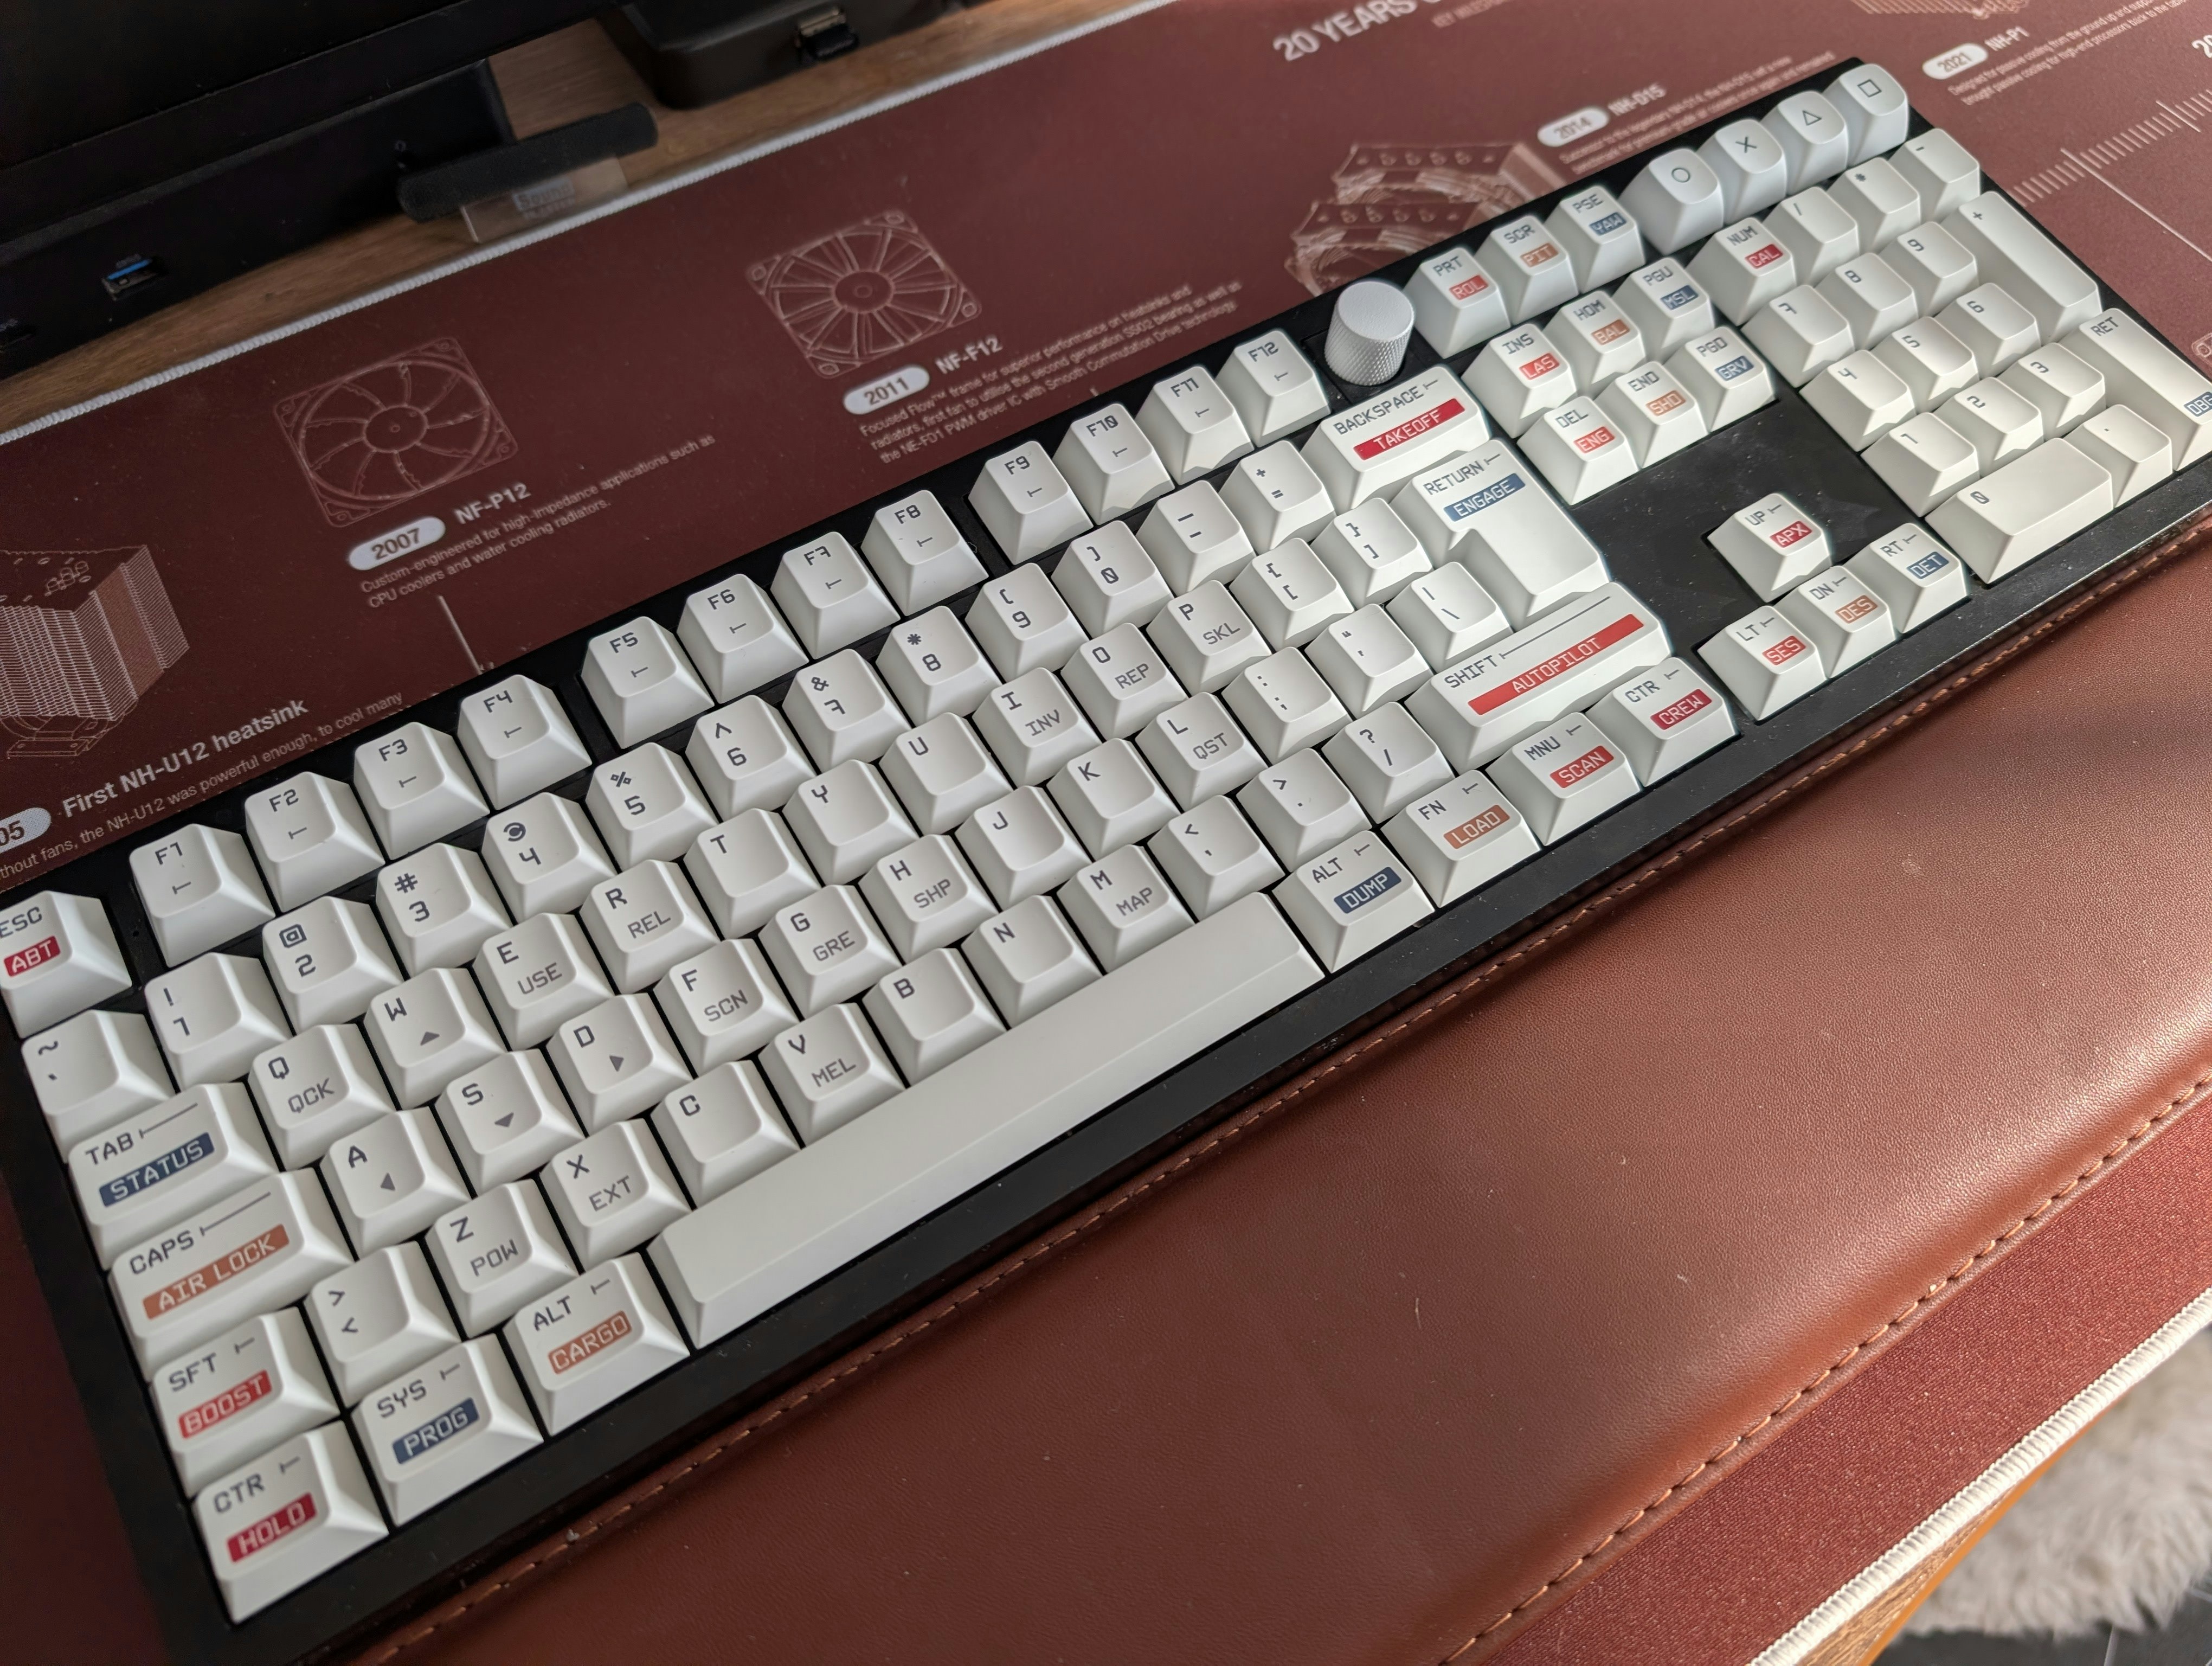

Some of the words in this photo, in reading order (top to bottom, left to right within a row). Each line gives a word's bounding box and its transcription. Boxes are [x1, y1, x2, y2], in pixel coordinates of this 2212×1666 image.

[1272, 28, 1320, 62] 20
[1311, 0, 1418, 43] YEARS
[1984, 26, 2030, 52] NH-P1
[2048, 35, 2070, 48] from
[2066, 29, 2082, 40] the
[2079, 16, 2107, 35] ground
[2091, 23, 2132, 46] processors
[2127, 14, 2150, 27] back
[1938, 52, 1972, 73] 2021
[1554, 117, 1592, 139] 2014
[1572, 194, 1604, 213] PSE
[1504, 225, 1533, 243] SCR
[1728, 226, 1757, 243] NUM
[1432, 256, 1462, 276] PRT
[1523, 246, 1554, 266] PIT
[1748, 247, 1780, 267] CAL
[1643, 266, 1674, 286] PGU
[1452, 279, 1484, 298] ROL
[1663, 289, 1695, 309] MSL
[1573, 299, 1606, 321] HOM
[1595, 325, 1628, 344] BAL
[2091, 317, 2118, 336] RET
[934, 334, 1003, 374] NF-F12
[1248, 342, 1278, 362] F12
[1503, 334, 1534, 354] INS
[1696, 337, 1727, 356] PGD
[1522, 356, 1555, 378] LAS
[1718, 360, 1750, 380] GRV
[864, 377, 910, 406] 2011
[1171, 378, 1199, 397] F11
[1628, 371, 1660, 392] END
[880, 448, 901, 464] the
[944, 414, 977, 435] PWM
[976, 402, 1007, 421] driver
[1020, 385, 1047, 401] with
[1044, 366, 1088, 390] Smooth
[923, 410, 947, 427] first
[946, 402, 966, 417] fan
[1333, 386, 1424, 435] BACKSPACE
[1649, 393, 1682, 414] SHD
[2187, 395, 2212, 415] DBG
[859, 409, 909, 436] Focused
[1086, 415, 1118, 437] F10
[1373, 409, 1443, 450] TAKEOFF
[1555, 410, 1589, 428] DEL
[1578, 430, 1609, 452] ENG
[1005, 456, 1030, 475] F9
[1423, 460, 1485, 496] RETURN
[454, 482, 531, 524] NF-P12
[1453, 479, 1516, 517] ENGAGE
[361, 533, 483, 593] Custom-engineered
[501, 486, 598, 533] high-impedance
[599, 456, 669, 490] applications
[669, 440, 699, 460] such
[699, 434, 716, 447] as
[895, 505, 921, 524] F8
[1745, 511, 1765, 526] UP
[371, 528, 420, 561] 2007
[1774, 523, 1809, 546] APX
[368, 588, 397, 608] CPU
[400, 570, 445, 595] coolers
[446, 558, 472, 575] and
[472, 542, 506, 563] water
[510, 523, 554, 547] cooling
[555, 499, 611, 528] radiators.
[804, 546, 831, 566] F7
[1881, 541, 1903, 556] RT
[1910, 554, 1944, 578] DET
[708, 589, 735, 610] F6
[1809, 584, 1835, 600] DN
[1179, 604, 1193, 620] P
[1839, 599, 1874, 621] DES
[610, 632, 638, 653] F5
[1203, 623, 1240, 644] SKL
[1737, 624, 1759, 641] LT
[1092, 647, 1110, 663] O
[1766, 639, 1801, 663] SES
[1115, 663, 1148, 689] REP
[1444, 655, 1502, 689] SHIFT
[1512, 638, 1602, 694] AUTOPILOT
[484, 690, 512, 713] F4
[1001, 691, 1022, 710] I
[1625, 681, 1660, 702] CTR
[1659, 694, 1703, 726] CREW
[1025, 709, 1059, 736] INV
[1167, 720, 1188, 734] L
[378, 739, 408, 761] F3
[1193, 733, 1227, 759] QST
[1524, 736, 1560, 760] MNU
[63, 782, 118, 817] First
[120, 742, 209, 792] NH-U12
[211, 700, 308, 752] heatsink
[1558, 751, 1606, 784] SCAN
[41, 840, 78, 862] fans,
[80, 825, 104, 843] the
[107, 798, 165, 830] NH-U12
[168, 785, 197, 804] was
[200, 755, 260, 790] powerful
[263, 732, 318, 762] enough,
[318, 725, 332, 736] to
[336, 708, 364, 729] cool
[366, 692, 402, 715] many
[269, 789, 298, 812] F2
[1418, 800, 1446, 819] FN
[1451, 811, 1501, 844] LOAD
[155, 842, 182, 864] F1
[710, 835, 726, 854] T
[890, 860, 911, 881] H
[1090, 870, 1112, 890] M
[1313, 857, 1342, 883] ALT
[605, 888, 627, 909] R
[914, 879, 950, 908] SHP
[1116, 888, 1152, 916] MAP
[1342, 874, 1389, 908] DUMP
[0, 907, 42, 938] ESC
[628, 911, 671, 938] REL
[790, 913, 810, 932] G
[11, 940, 53, 973] ABT
[497, 941, 519, 964] E
[813, 931, 855, 961] GRE
[518, 963, 562, 994] USE
[681, 969, 697, 991] F
[704, 990, 748, 1021] SCN
[788, 1035, 805, 1054] V
[268, 1057, 289, 1079] Q
[812, 1059, 856, 1087] MEL
[288, 1078, 334, 1113] QCK
[86, 1133, 133, 1164] TAB
[111, 1140, 203, 1200] STATUS
[567, 1155, 589, 1178] X
[589, 1176, 631, 1211] EXT
[450, 1217, 473, 1242] Z
[130, 1230, 195, 1274] CAPS
[471, 1240, 518, 1277] POW
[159, 1276, 207, 1311] AIR
[214, 1236, 275, 1279] LOCK
[534, 1296, 571, 1331] ALT
[552, 1317, 628, 1370] CARGO
[169, 1353, 216, 1392] SFT
[184, 1374, 263, 1433] BOOST
[377, 1380, 426, 1418] SYS
[403, 1407, 468, 1456] PROG
[214, 1473, 264, 1513] CTR
